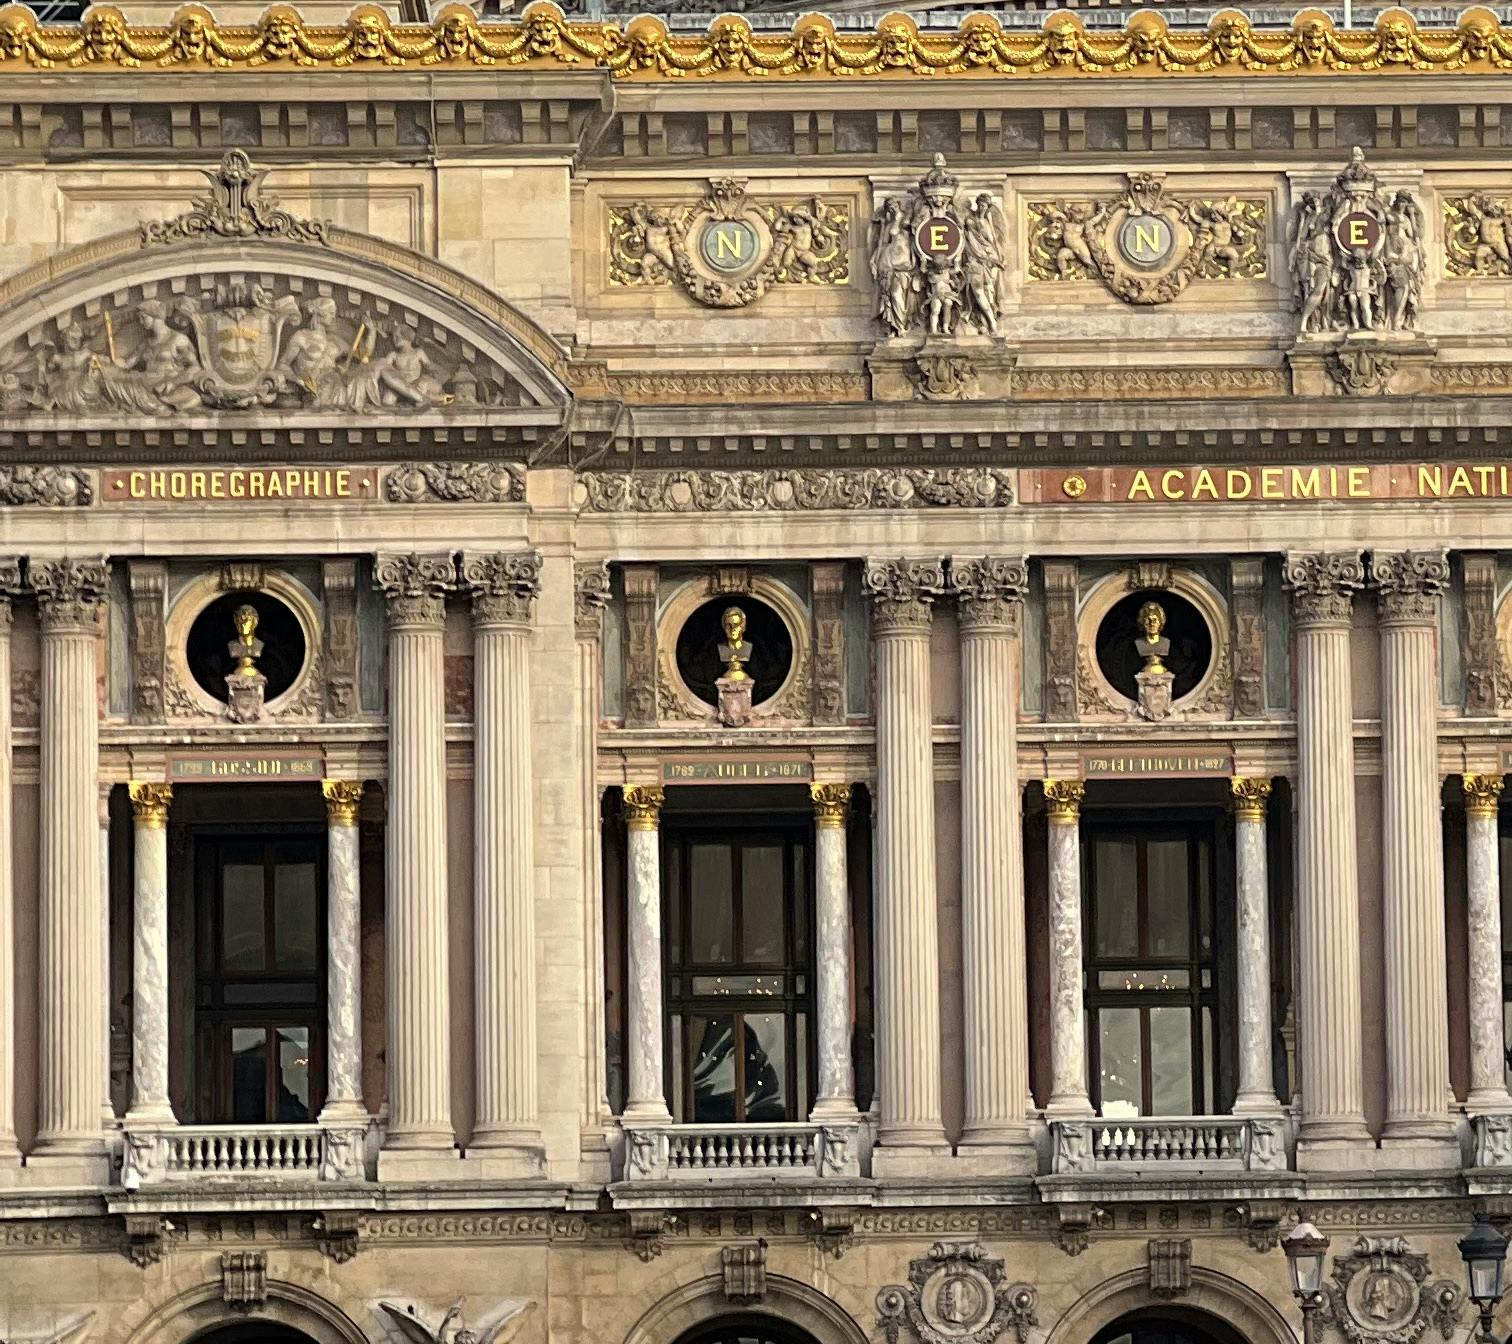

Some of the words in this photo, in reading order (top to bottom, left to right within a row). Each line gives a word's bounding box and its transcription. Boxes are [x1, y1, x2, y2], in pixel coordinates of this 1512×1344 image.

[716, 230, 743, 259] N
[930, 224, 949, 252] E
[1135, 224, 1161, 254] N
[1350, 220, 1369, 246] E
[130, 470, 351, 498] CHOREGRAPHIE
[1128, 467, 1370, 499] ACADEMIE
